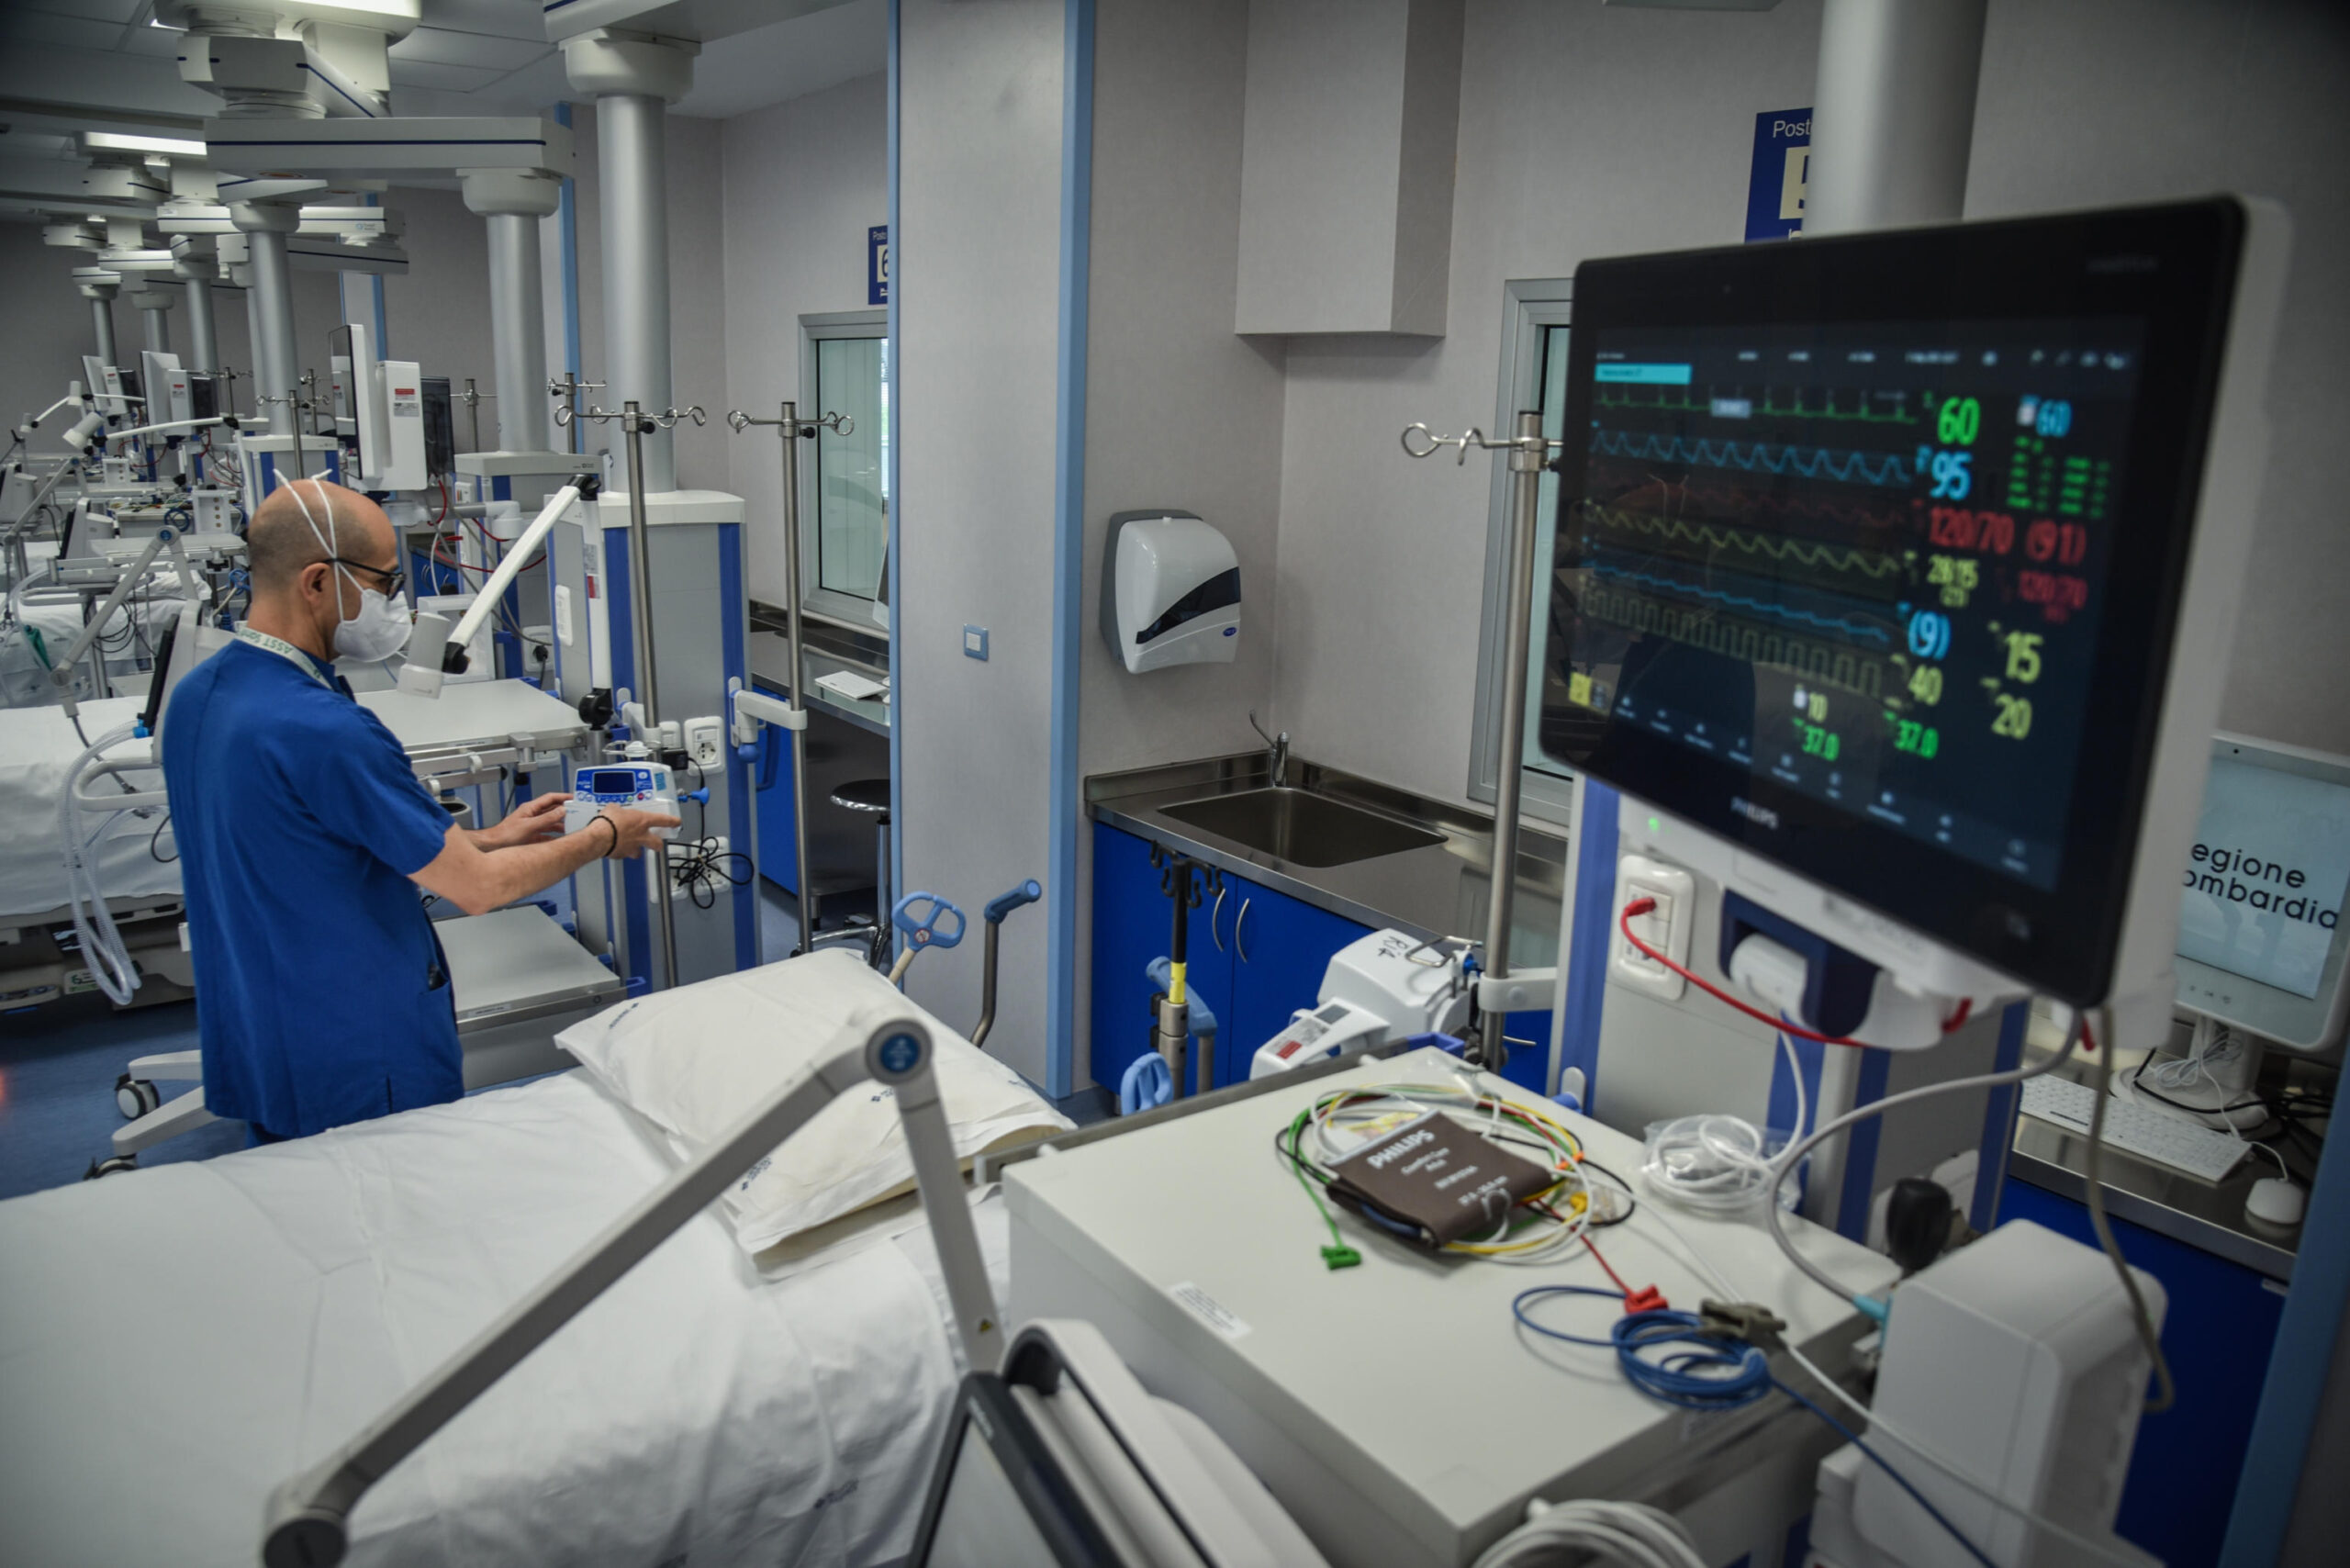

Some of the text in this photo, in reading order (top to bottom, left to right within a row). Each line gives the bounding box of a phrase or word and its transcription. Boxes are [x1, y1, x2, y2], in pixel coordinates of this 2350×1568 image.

[1937, 396, 1981, 445] 60
[1930, 450, 1973, 500] 95
[1930, 506, 2016, 554] 120/70
[1908, 609, 1952, 662] (9)
[2005, 629, 2044, 685] 15
[1908, 664, 1944, 707] 40
[1990, 693, 2033, 741] 20
[1730, 795, 1779, 830] PHILIPS
[1366, 1128, 1435, 1170] PHILIPS
